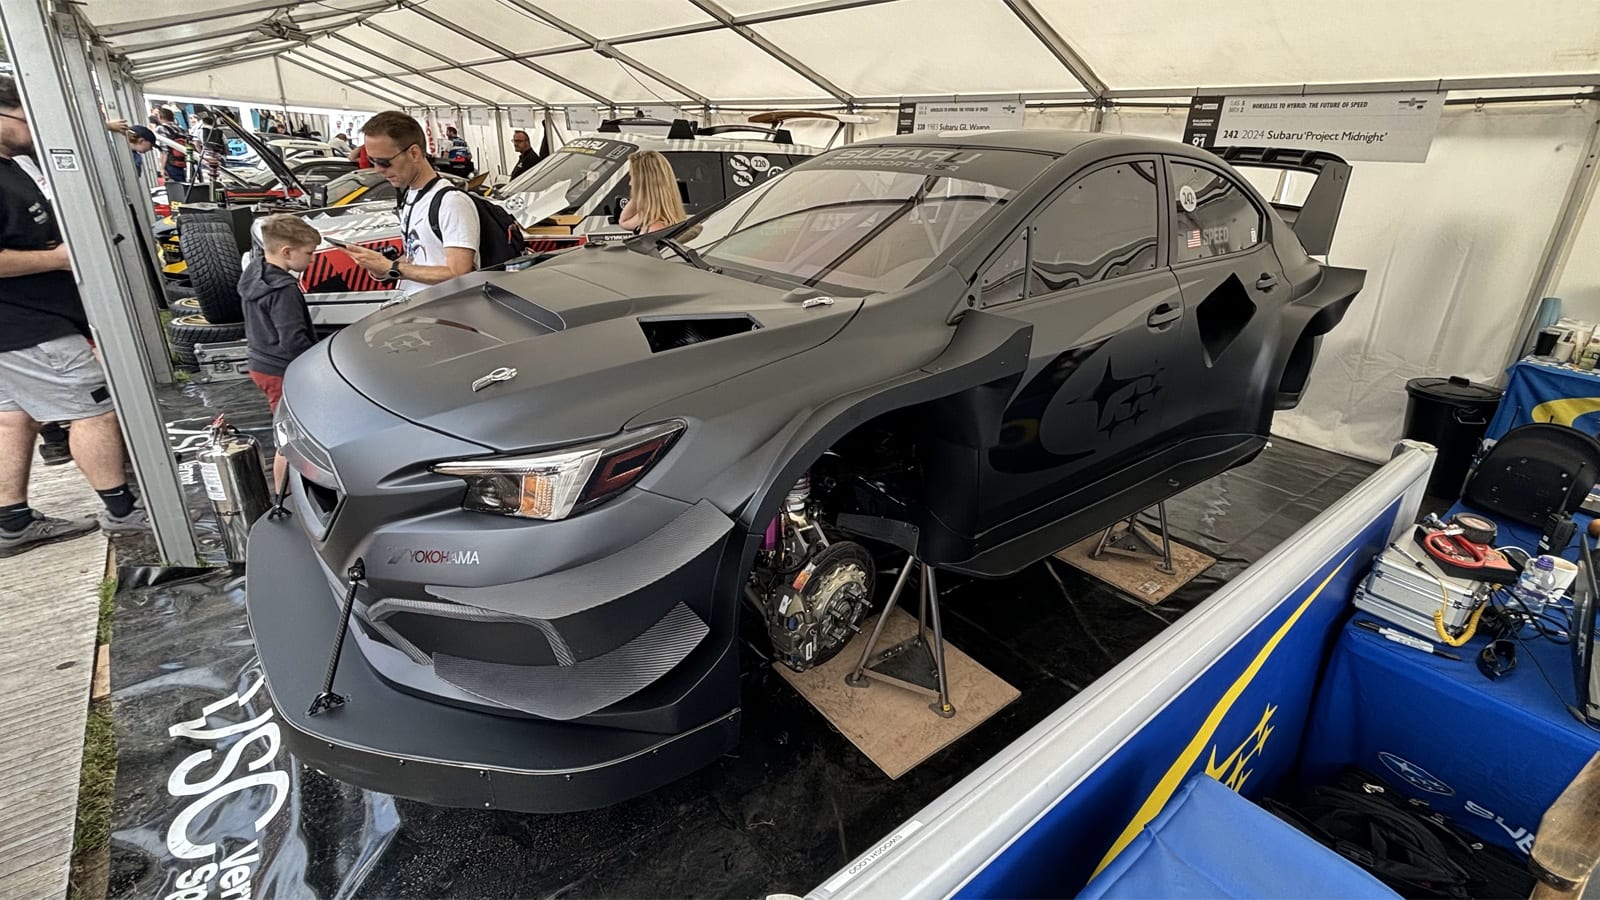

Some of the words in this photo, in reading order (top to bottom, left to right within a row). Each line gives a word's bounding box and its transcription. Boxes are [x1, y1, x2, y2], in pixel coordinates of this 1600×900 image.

[1192, 137, 1206, 147] 91
[1223, 130, 1239, 139] 242
[1241, 130, 1265, 140] 2024
[1267, 130, 1303, 140] Subaru
[833, 149, 983, 164] SUBARU
[351, 222, 401, 232] YOKO
[1203, 227, 1229, 245] SPEED
[409, 550, 480, 565] YOKOHAMA
[1464, 800, 1535, 854] SUB
[219, 839, 260, 900] Ver
